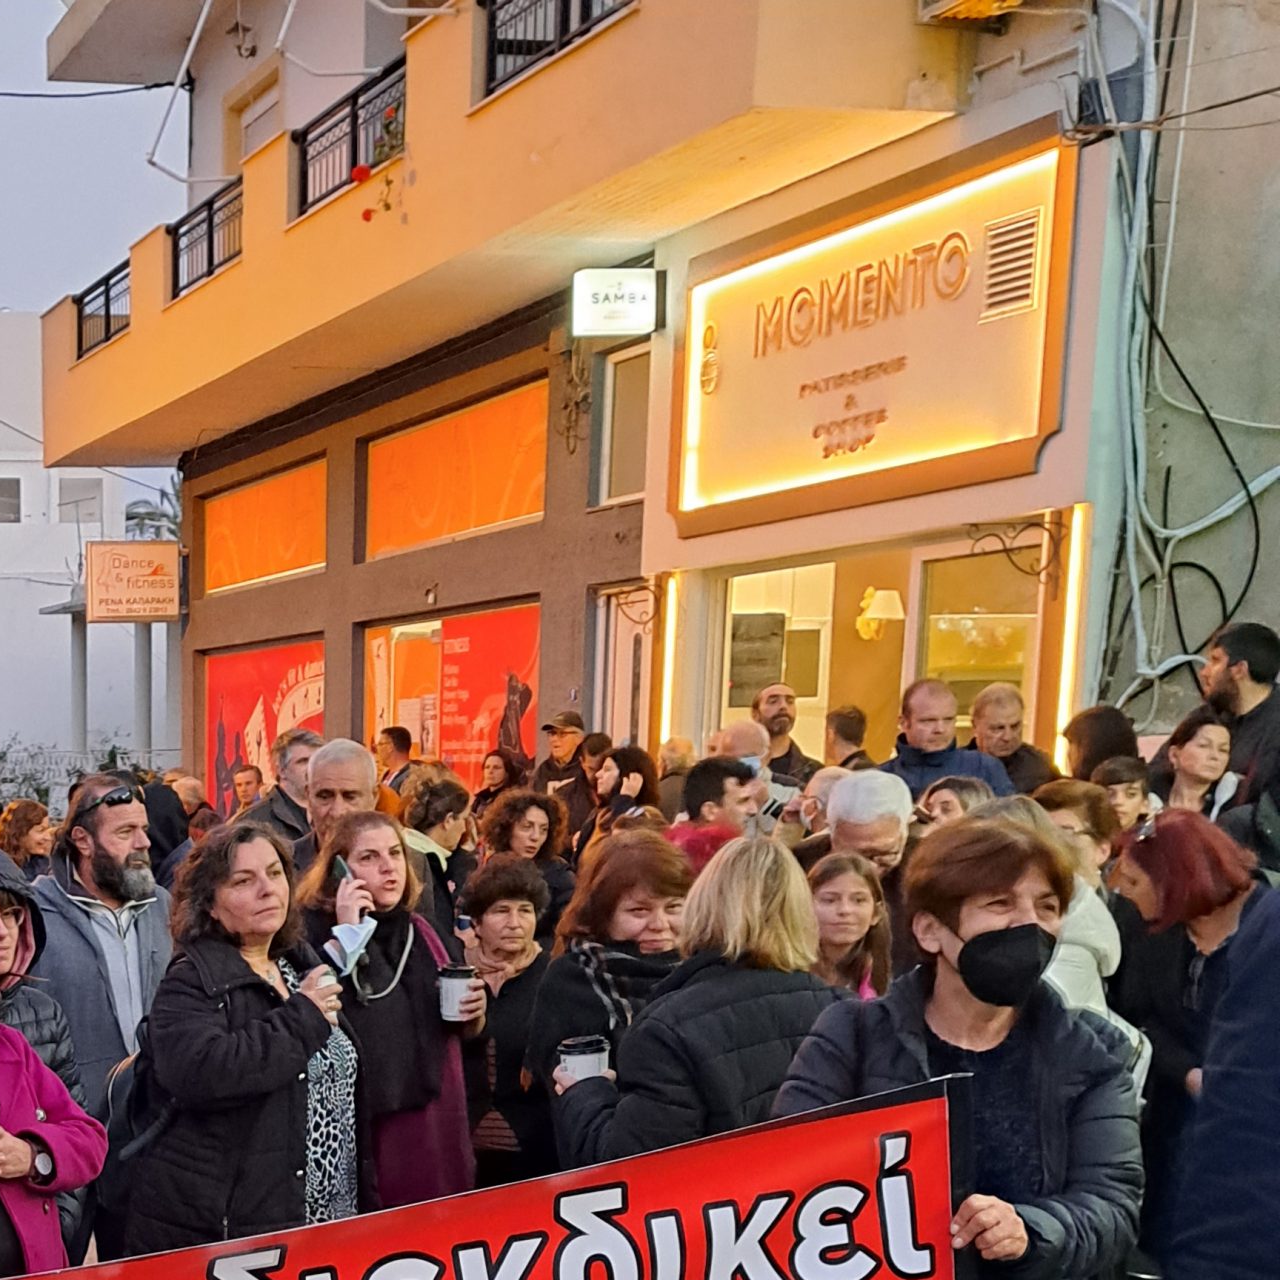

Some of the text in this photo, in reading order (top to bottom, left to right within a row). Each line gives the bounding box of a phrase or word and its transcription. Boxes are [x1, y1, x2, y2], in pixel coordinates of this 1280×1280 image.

[753, 231, 971, 358] MOMENTO
[112, 557, 155, 569] Dance
[127, 576, 175, 589] fitness
